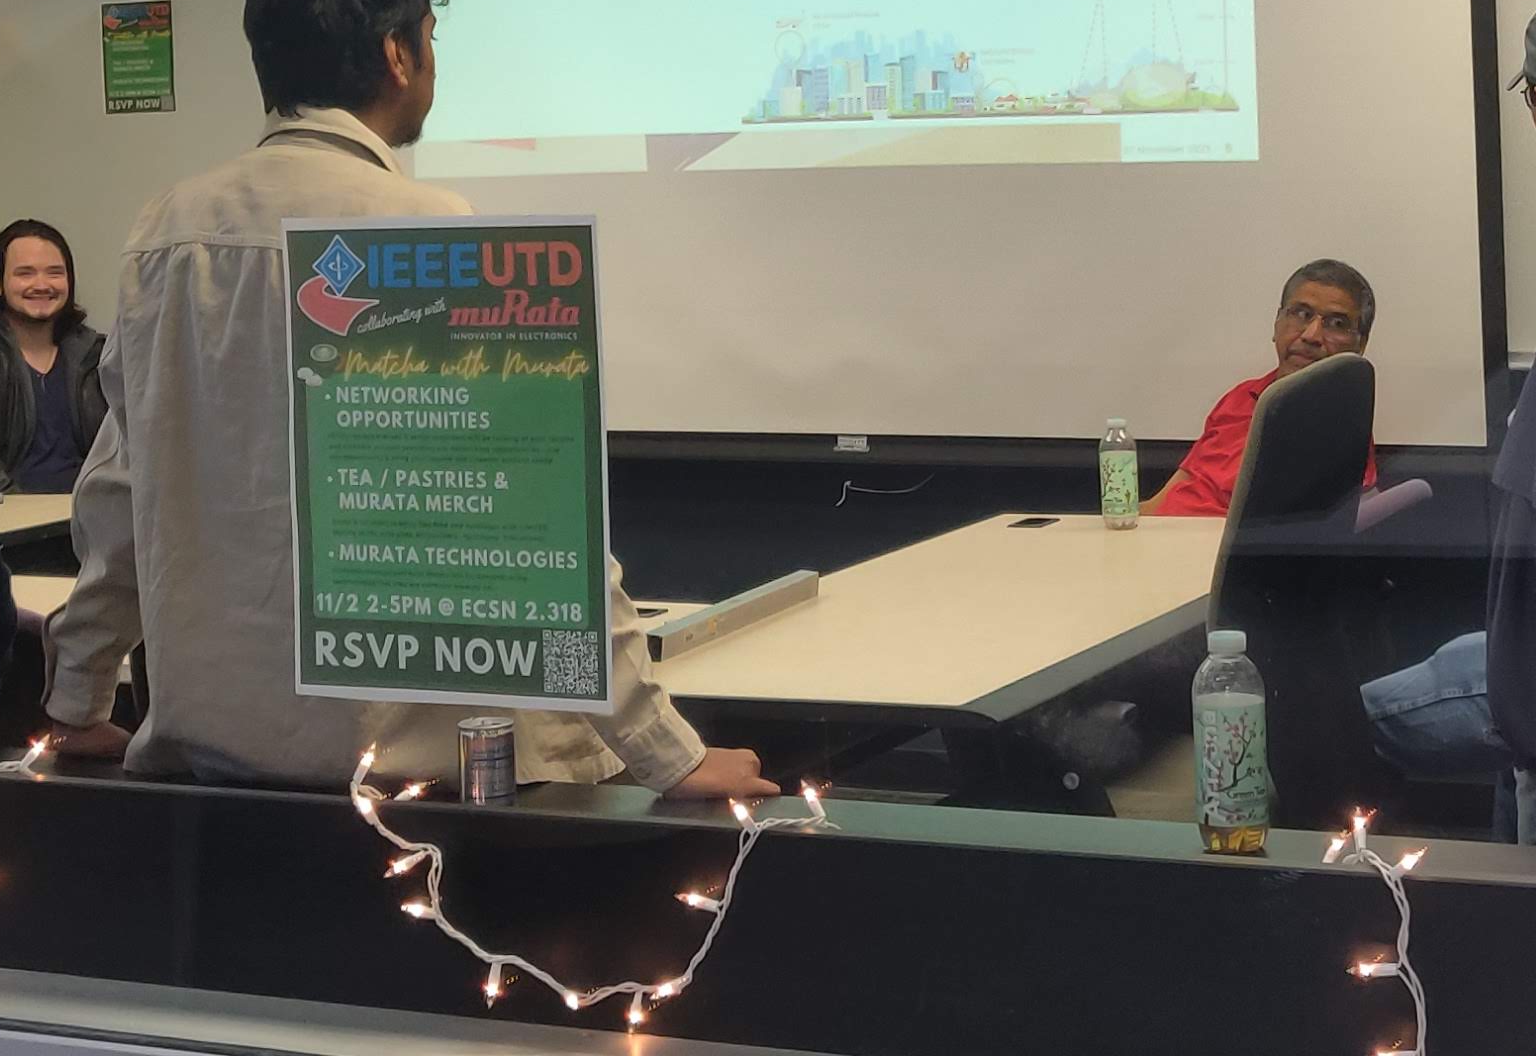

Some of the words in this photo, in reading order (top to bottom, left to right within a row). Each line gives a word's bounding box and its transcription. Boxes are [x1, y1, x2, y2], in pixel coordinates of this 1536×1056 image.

[108, 99, 133, 111] RSVP
[136, 98, 161, 109] NOW
[357, 308, 422, 334] collaborating
[425, 297, 447, 316] with
[447, 290, 580, 326] muRata
[450, 332, 503, 341] INNOVATOR
[506, 332, 516, 341] IN
[519, 332, 578, 341] ELECTRONICS
[344, 346, 429, 380] Matcha
[440, 346, 490, 380] with
[502, 348, 590, 382] Murata
[336, 386, 470, 405] NETWORKING
[336, 410, 491, 429] OPPORTUNITIES
[338, 468, 373, 486] TEA
[395, 469, 487, 489] PASTRIES
[494, 471, 509, 490] &
[338, 492, 420, 511] MURATA
[425, 494, 493, 513] MERCH
[339, 544, 420, 564] MURATA
[425, 547, 579, 569] TECHNOLOGIES
[315, 593, 359, 614] 11/2
[366, 594, 432, 616] 2-5PM
[438, 598, 455, 616] @
[462, 598, 516, 620] ECSN
[524, 601, 583, 623] 2.318
[315, 630, 420, 670] RSVP
[434, 636, 537, 677] NOW
